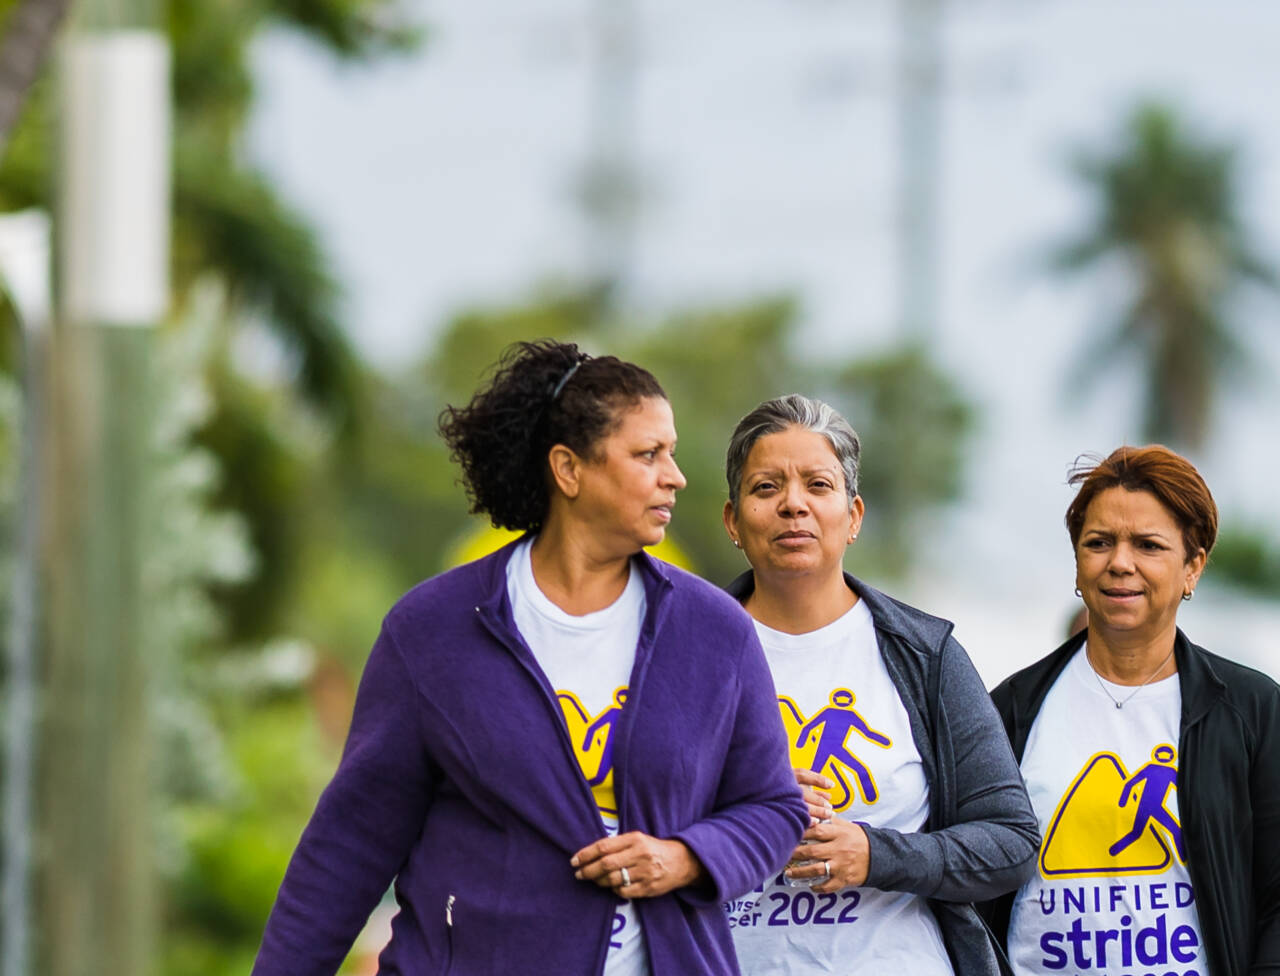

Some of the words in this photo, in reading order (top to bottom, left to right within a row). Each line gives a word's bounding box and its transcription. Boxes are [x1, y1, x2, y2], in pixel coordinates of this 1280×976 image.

[767, 890, 862, 926] 2022
[1039, 882, 1196, 915] UNIFIED
[728, 912, 762, 928] cer
[1039, 913, 1199, 970] stride
